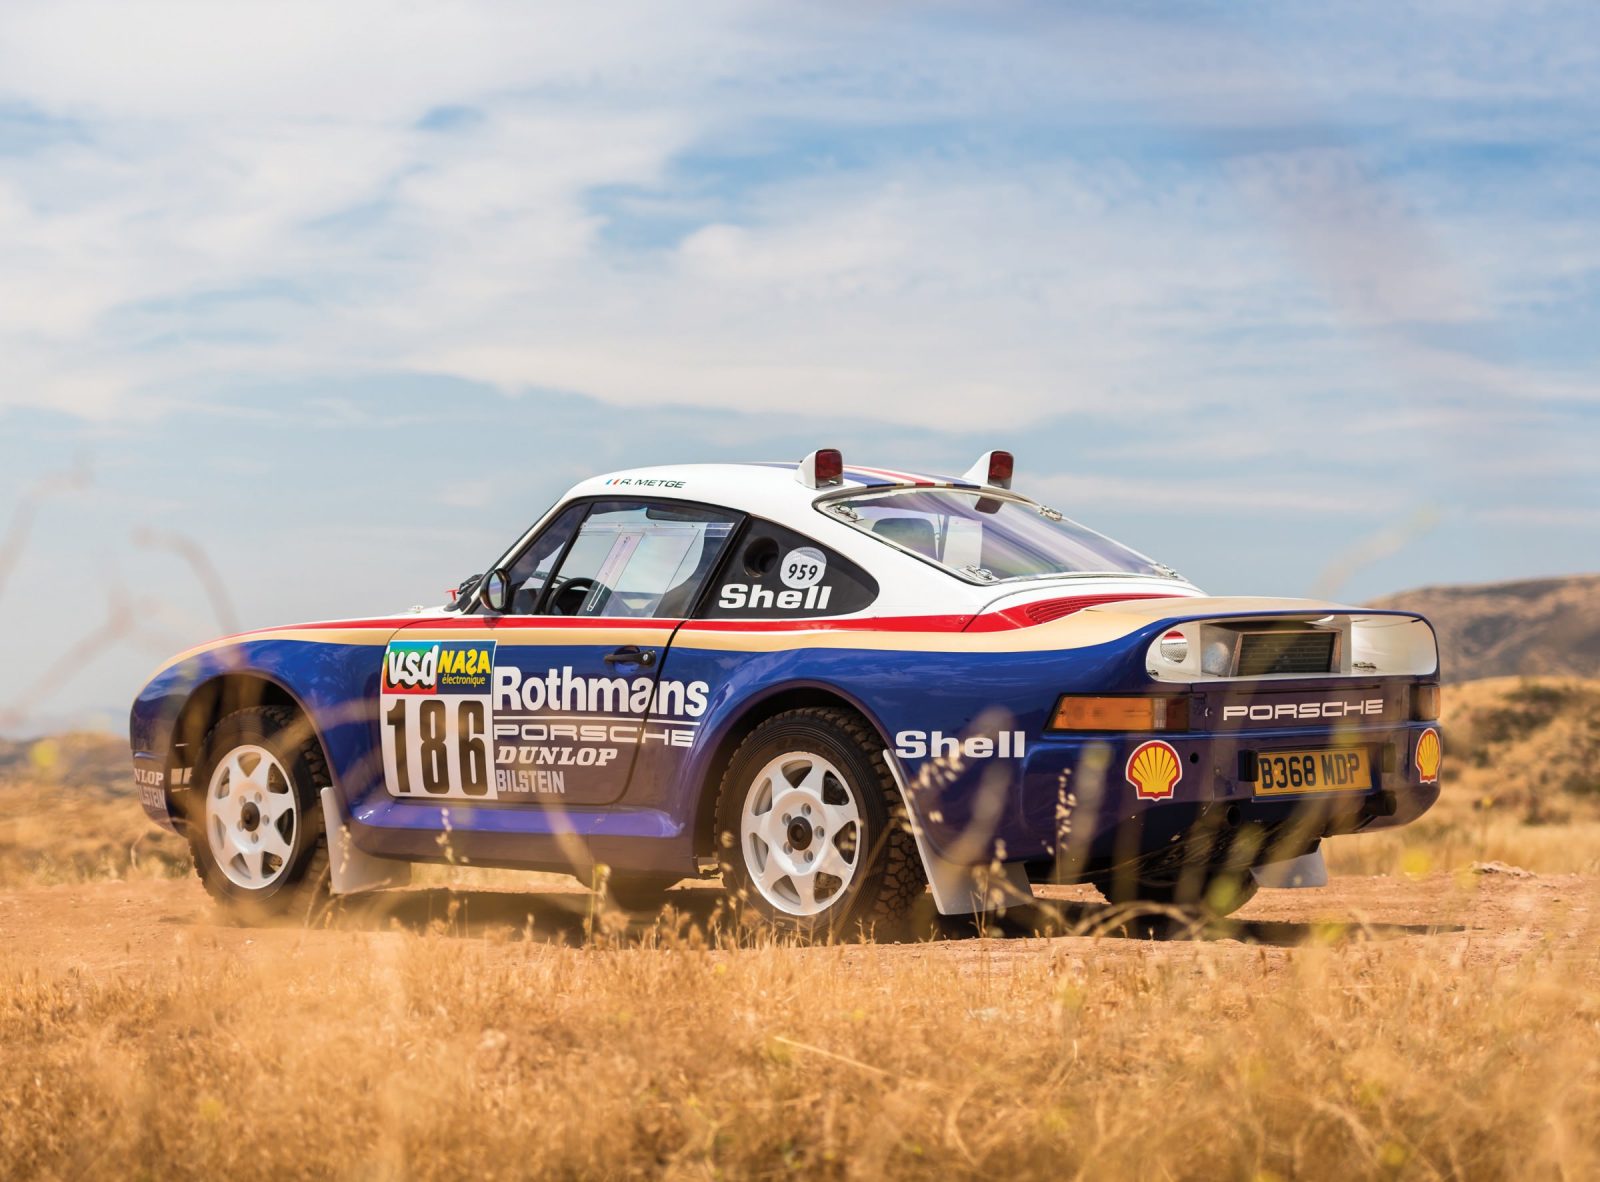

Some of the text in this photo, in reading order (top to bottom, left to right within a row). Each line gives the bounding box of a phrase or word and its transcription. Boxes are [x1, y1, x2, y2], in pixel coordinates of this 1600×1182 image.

[634, 479, 687, 489] METGE
[788, 563, 818, 581] 959
[718, 584, 832, 609] Shell
[441, 674, 485, 688] électronique
[493, 666, 709, 717] Rothmans
[1223, 699, 1384, 721] PORSCHE
[386, 698, 489, 795] 186
[494, 724, 695, 748] PORSCHE
[895, 730, 1026, 759] Shell
[495, 745, 617, 767] DUNLOP
[496, 769, 565, 794] BILSTEIN
[1259, 752, 1360, 790] B368 MDP
